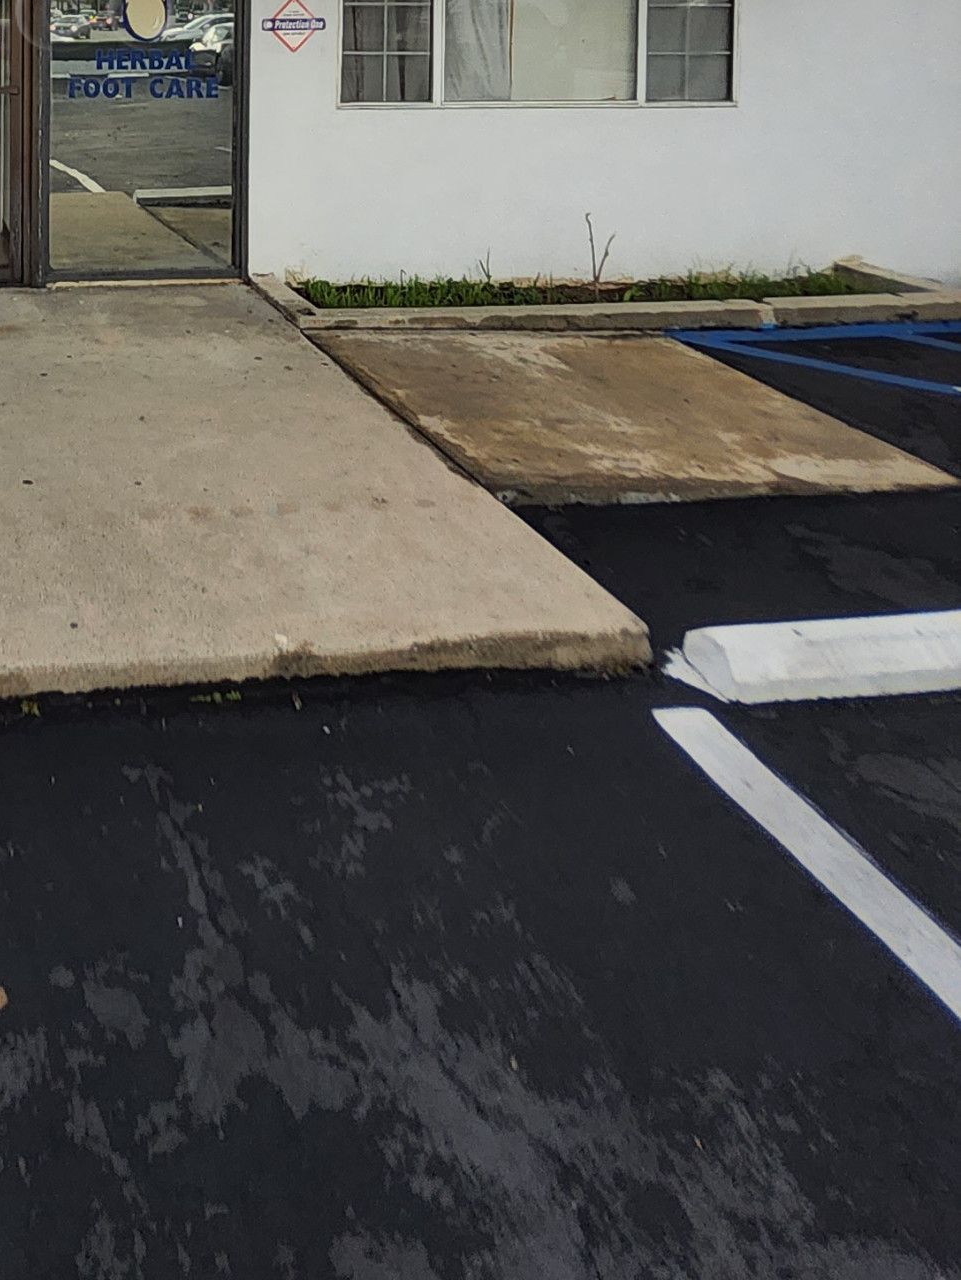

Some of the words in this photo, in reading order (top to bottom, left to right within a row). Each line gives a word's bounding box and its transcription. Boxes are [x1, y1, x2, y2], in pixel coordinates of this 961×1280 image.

[96, 48, 197, 70] HERBAL
[68, 77, 136, 99] FOOT
[149, 76, 219, 99] CARE
